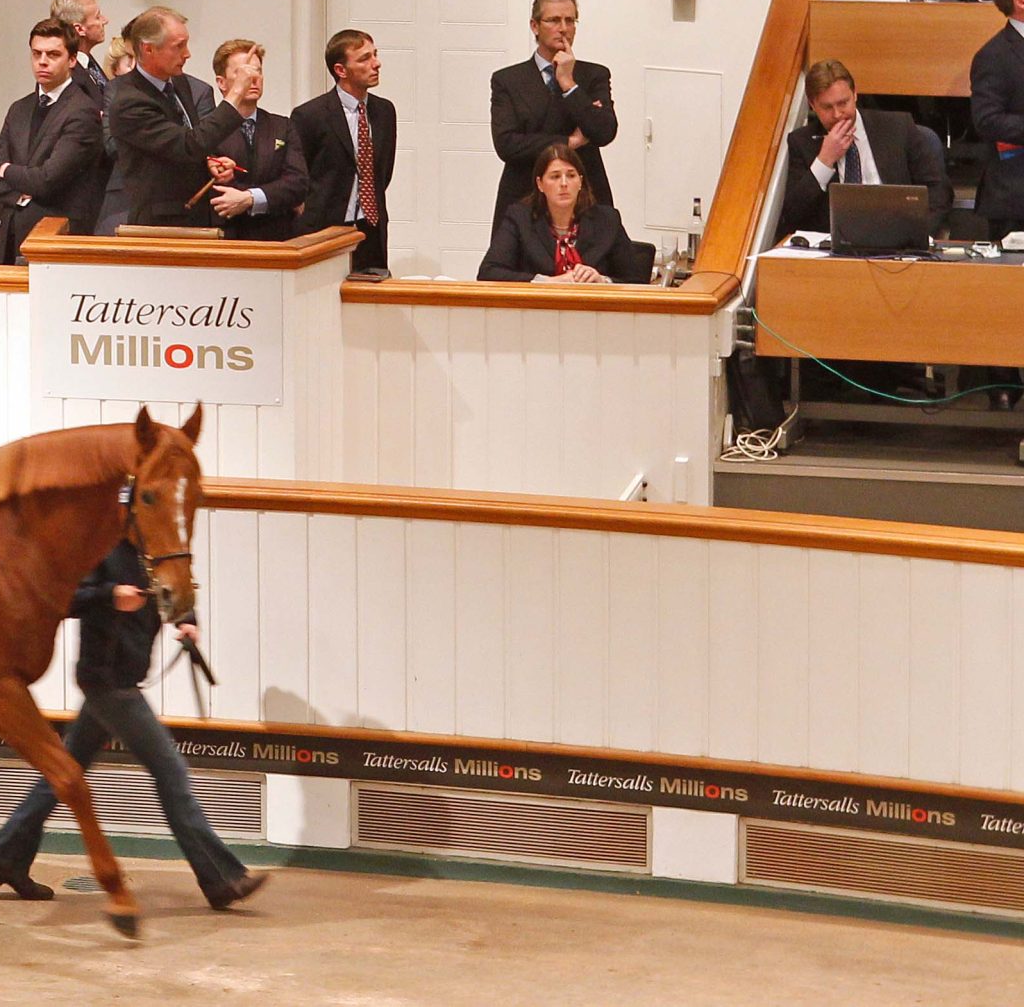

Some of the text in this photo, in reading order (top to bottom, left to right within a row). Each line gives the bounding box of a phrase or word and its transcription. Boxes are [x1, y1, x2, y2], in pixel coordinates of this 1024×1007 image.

[70, 293, 254, 328] Tattersalls
[70, 333, 254, 371] Millions
[171, 739, 340, 765] attersalls Millions
[362, 752, 542, 781] Tattersalls Millions
[567, 768, 749, 802] Tattersalls Millions
[772, 789, 956, 826] Tattersalls Millions
